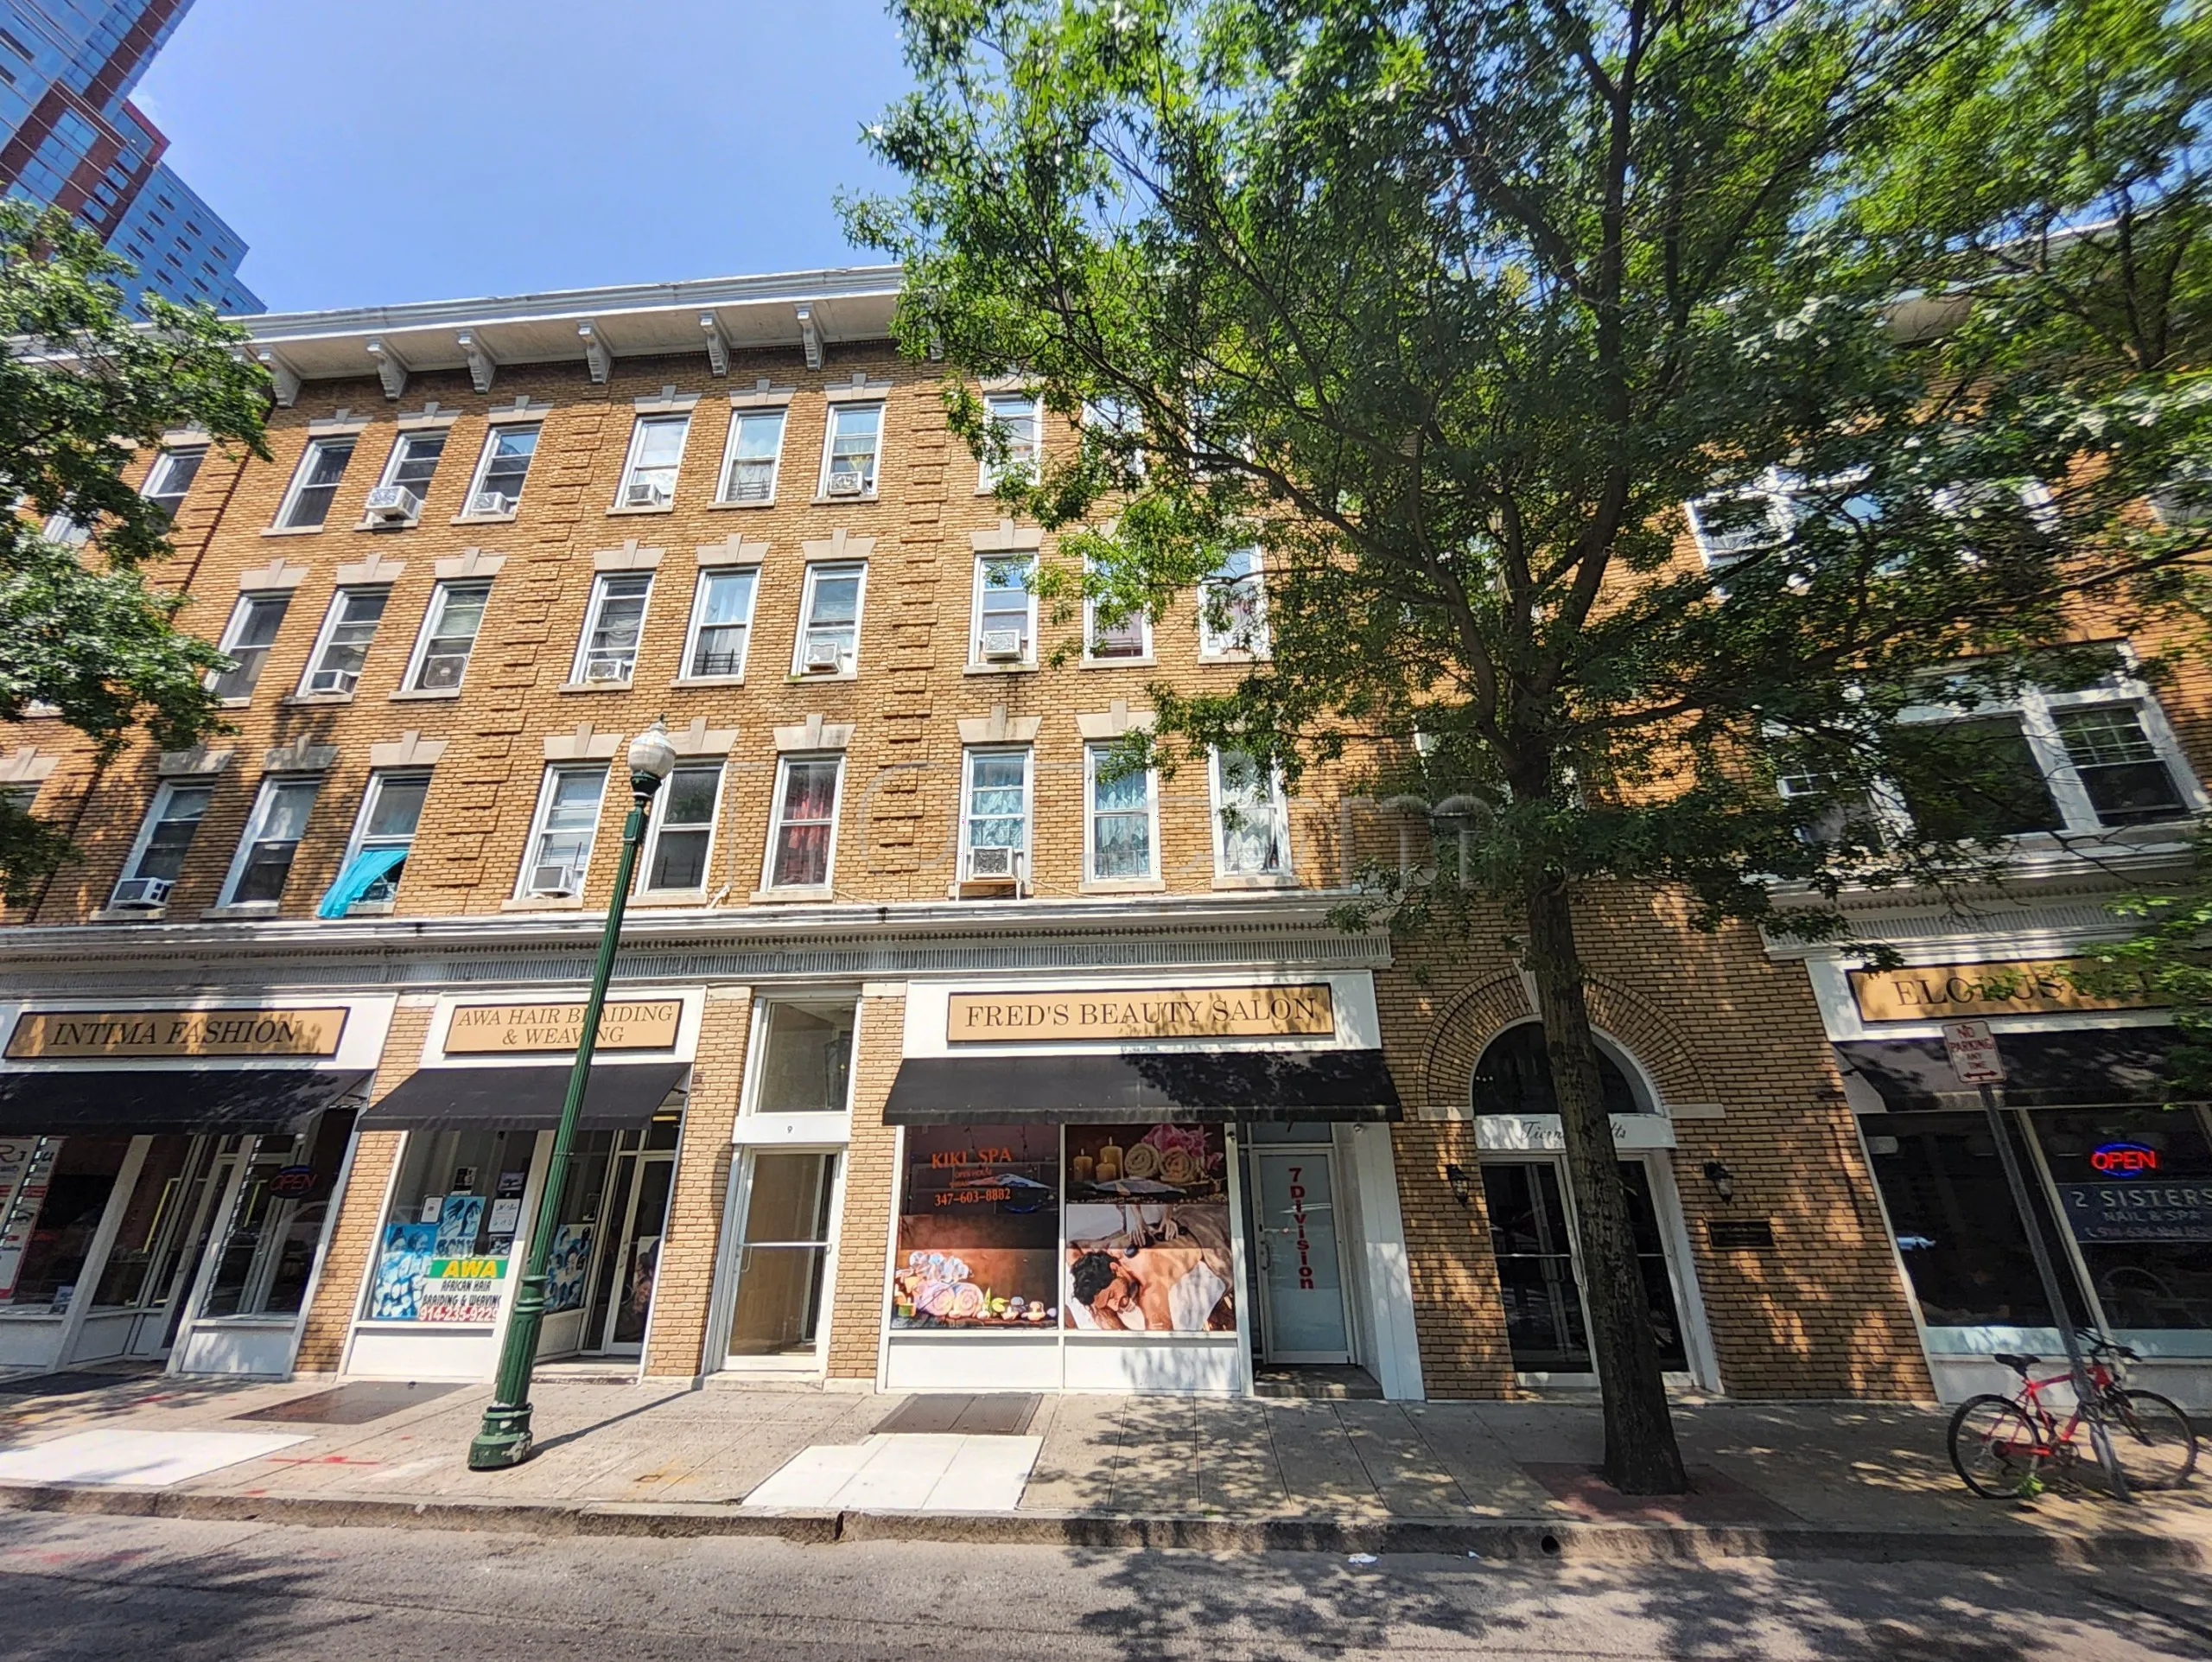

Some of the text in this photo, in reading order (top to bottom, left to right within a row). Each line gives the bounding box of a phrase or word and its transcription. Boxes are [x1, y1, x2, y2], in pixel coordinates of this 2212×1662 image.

[457, 1009, 501, 1027] AWA
[507, 1008, 561, 1025] HAIR
[965, 997, 1317, 1028] FRED'S BEAUTY SALON
[49, 1020, 301, 1047] INTIMA FASHION
[502, 1026, 625, 1045] & WEAVNG
[1955, 1024, 1975, 1038] NO
[1948, 1038, 1994, 1052] PARKING
[787, 1125, 793, 1134] 9
[931, 1147, 1013, 1169] KIKI SPA
[2090, 1150, 2158, 1170] OPEN
[270, 1174, 317, 1191] OPEN
[1288, 1168, 1302, 1182] 7
[2070, 1188, 2212, 1207] 2 SISTERS
[2102, 1210, 2147, 1222] NAIL
[2165, 1209, 2202, 1222] SPA
[1290, 1186, 1314, 1289] Division
[442, 1259, 498, 1278] AWA
[440, 1280, 493, 1292] AFRICAN HAIR
[422, 1294, 459, 1307] BRAIDING
[460, 1295, 467, 1307] &
